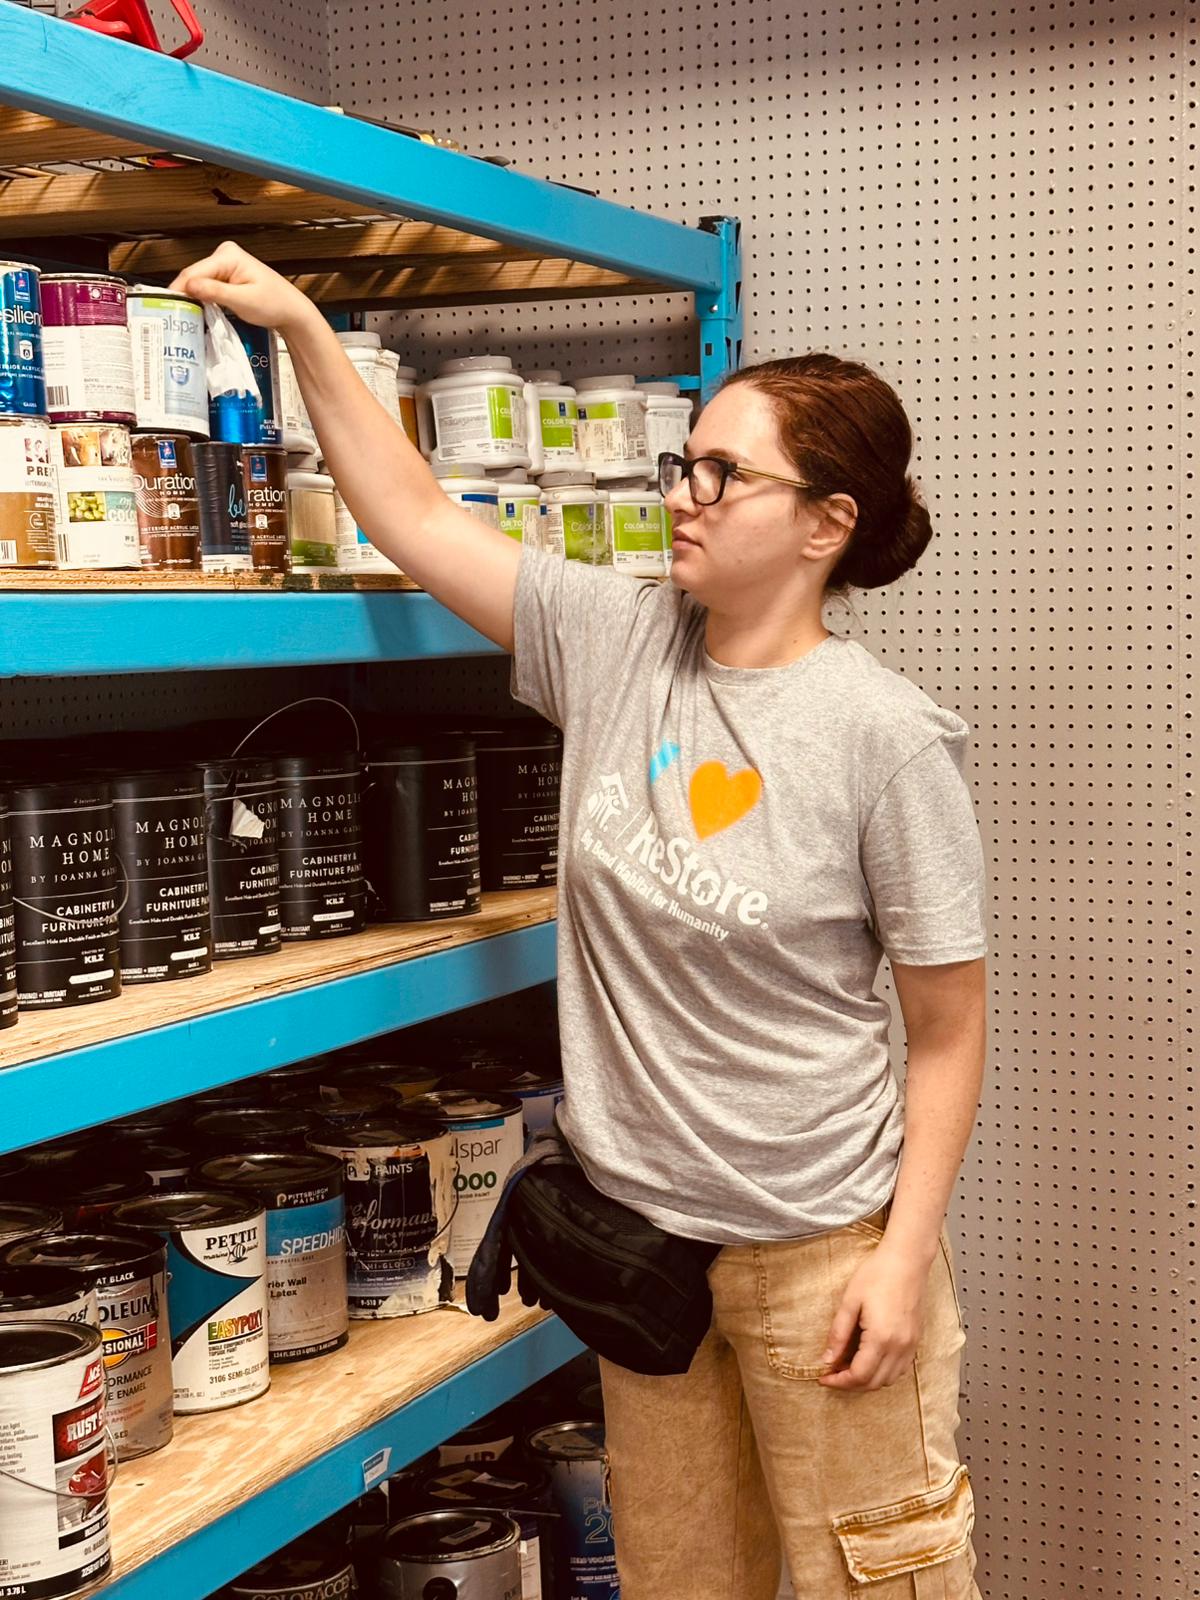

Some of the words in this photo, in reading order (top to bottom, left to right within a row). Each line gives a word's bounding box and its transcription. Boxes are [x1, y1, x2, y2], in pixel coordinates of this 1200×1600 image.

[308, 809, 352, 823] HOME
[164, 833, 204, 849] HOME
[62, 847, 110, 865] HOME
[136, 858, 150, 867] BY
[158, 855, 195, 866] JOANNA
[302, 853, 352, 866] CABINETRY
[31, 875, 46, 884] BY
[54, 871, 98, 883] JOANNA
[290, 866, 345, 879] FURNITURE
[160, 883, 204, 897] CABINETRY
[591, 839, 619, 870] Bend
[614, 860, 655, 901] Habitat
[650, 888, 670, 910] for
[668, 898, 730, 942] Humanity
[56, 901, 110, 917] CABINETRY
[146, 897, 200, 913] FURNITURE
[375, 1162, 413, 1176] PAINTS
[288, 1187, 328, 1200] PITTSBURGH
[293, 1194, 325, 1205] PAINTS
[206, 1226, 257, 1250] PETTIT
[96, 1277, 107, 1285] AT
[110, 1271, 135, 1284] BLACK
[287, 1277, 307, 1287] Wall
[270, 1289, 297, 1298] Latex
[208, 1307, 263, 1341] EASYPOXY
[209, 1375, 226, 1384] 3106
[228, 1365, 260, 1381] SEMI-GLOSS
[117, 1382, 146, 1399] ENAMEL
[67, 1412, 98, 1442] RUST
[6, 1586, 20, 1596] 3.78
[22, 1585, 26, 1594] L
